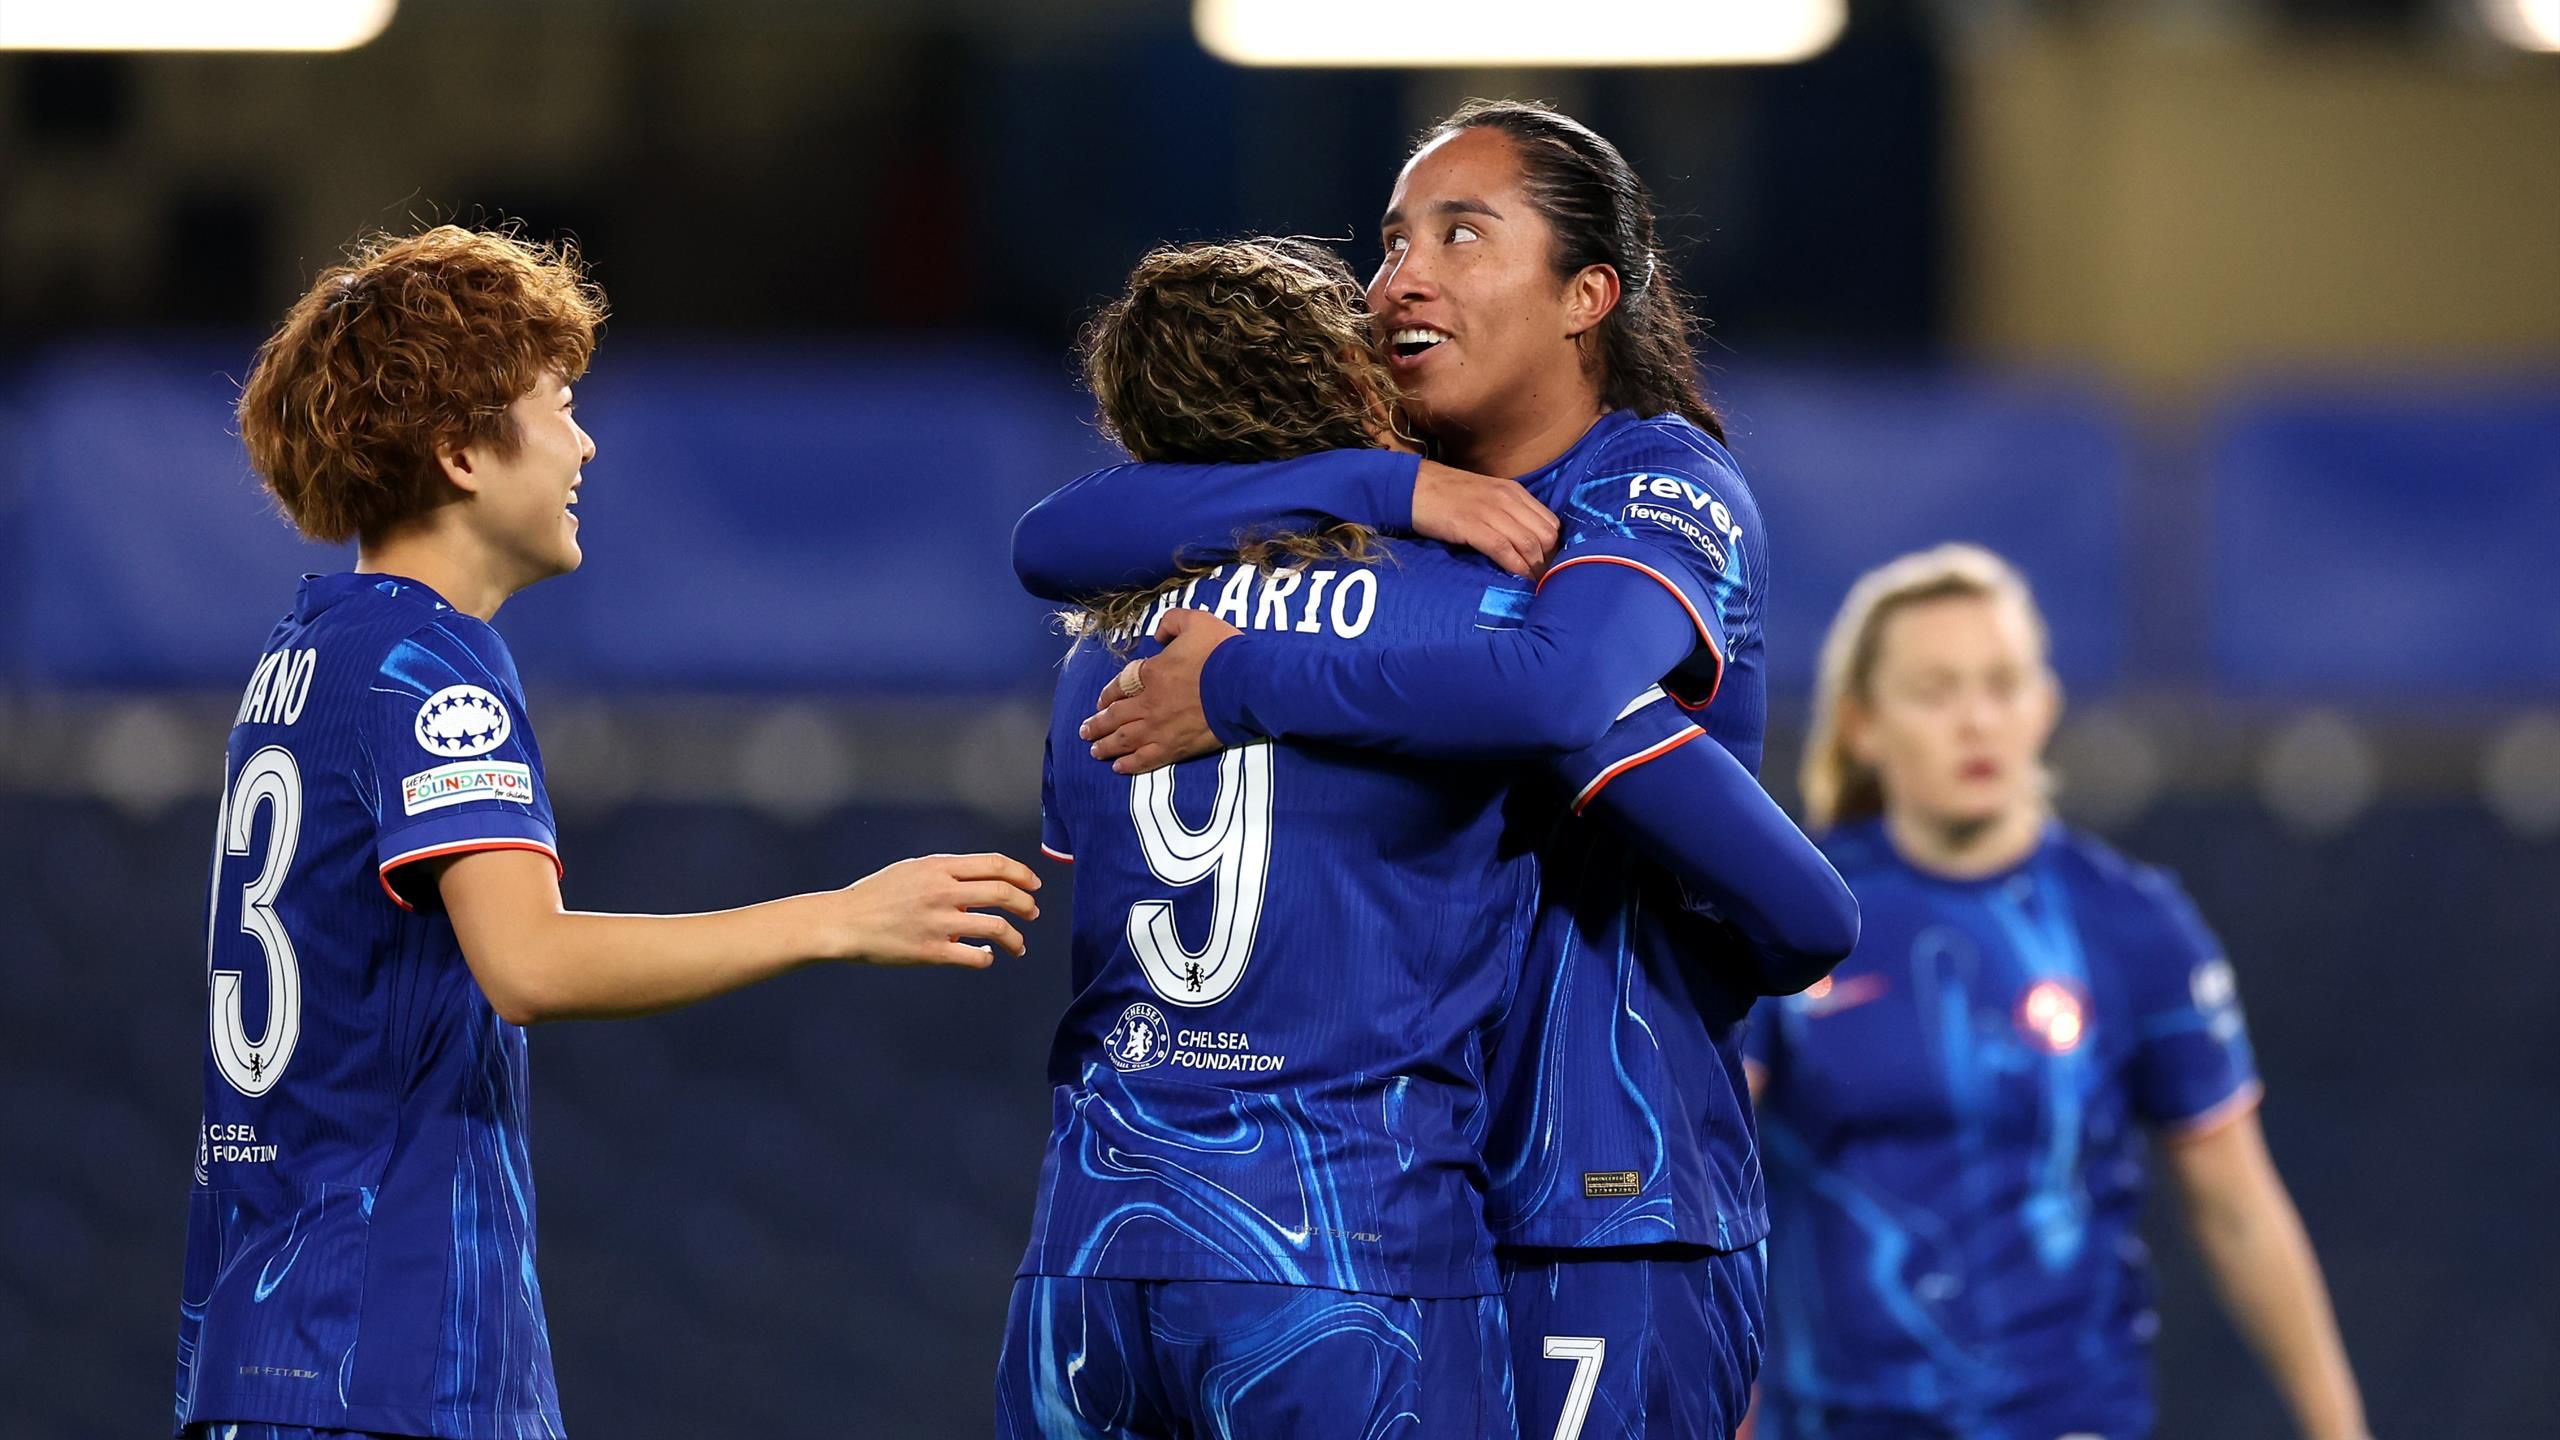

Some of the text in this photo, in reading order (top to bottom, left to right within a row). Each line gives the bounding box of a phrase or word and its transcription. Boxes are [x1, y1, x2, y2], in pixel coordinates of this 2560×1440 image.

[1629, 473, 1743, 545] fever
[1630, 505, 1727, 571] feverup.com
[405, 773, 432, 788] UEFA
[406, 773, 529, 802] FOUNDATION
[1127, 737, 1273, 1008] 9
[208, 744, 303, 1098] 3
[1124, 1005, 1161, 1025] CHELSEA
[1170, 1050, 1285, 1072] FOUNDATION
[1177, 1029, 1249, 1050] CHELSEA
[1543, 1336, 1606, 1440] 7
